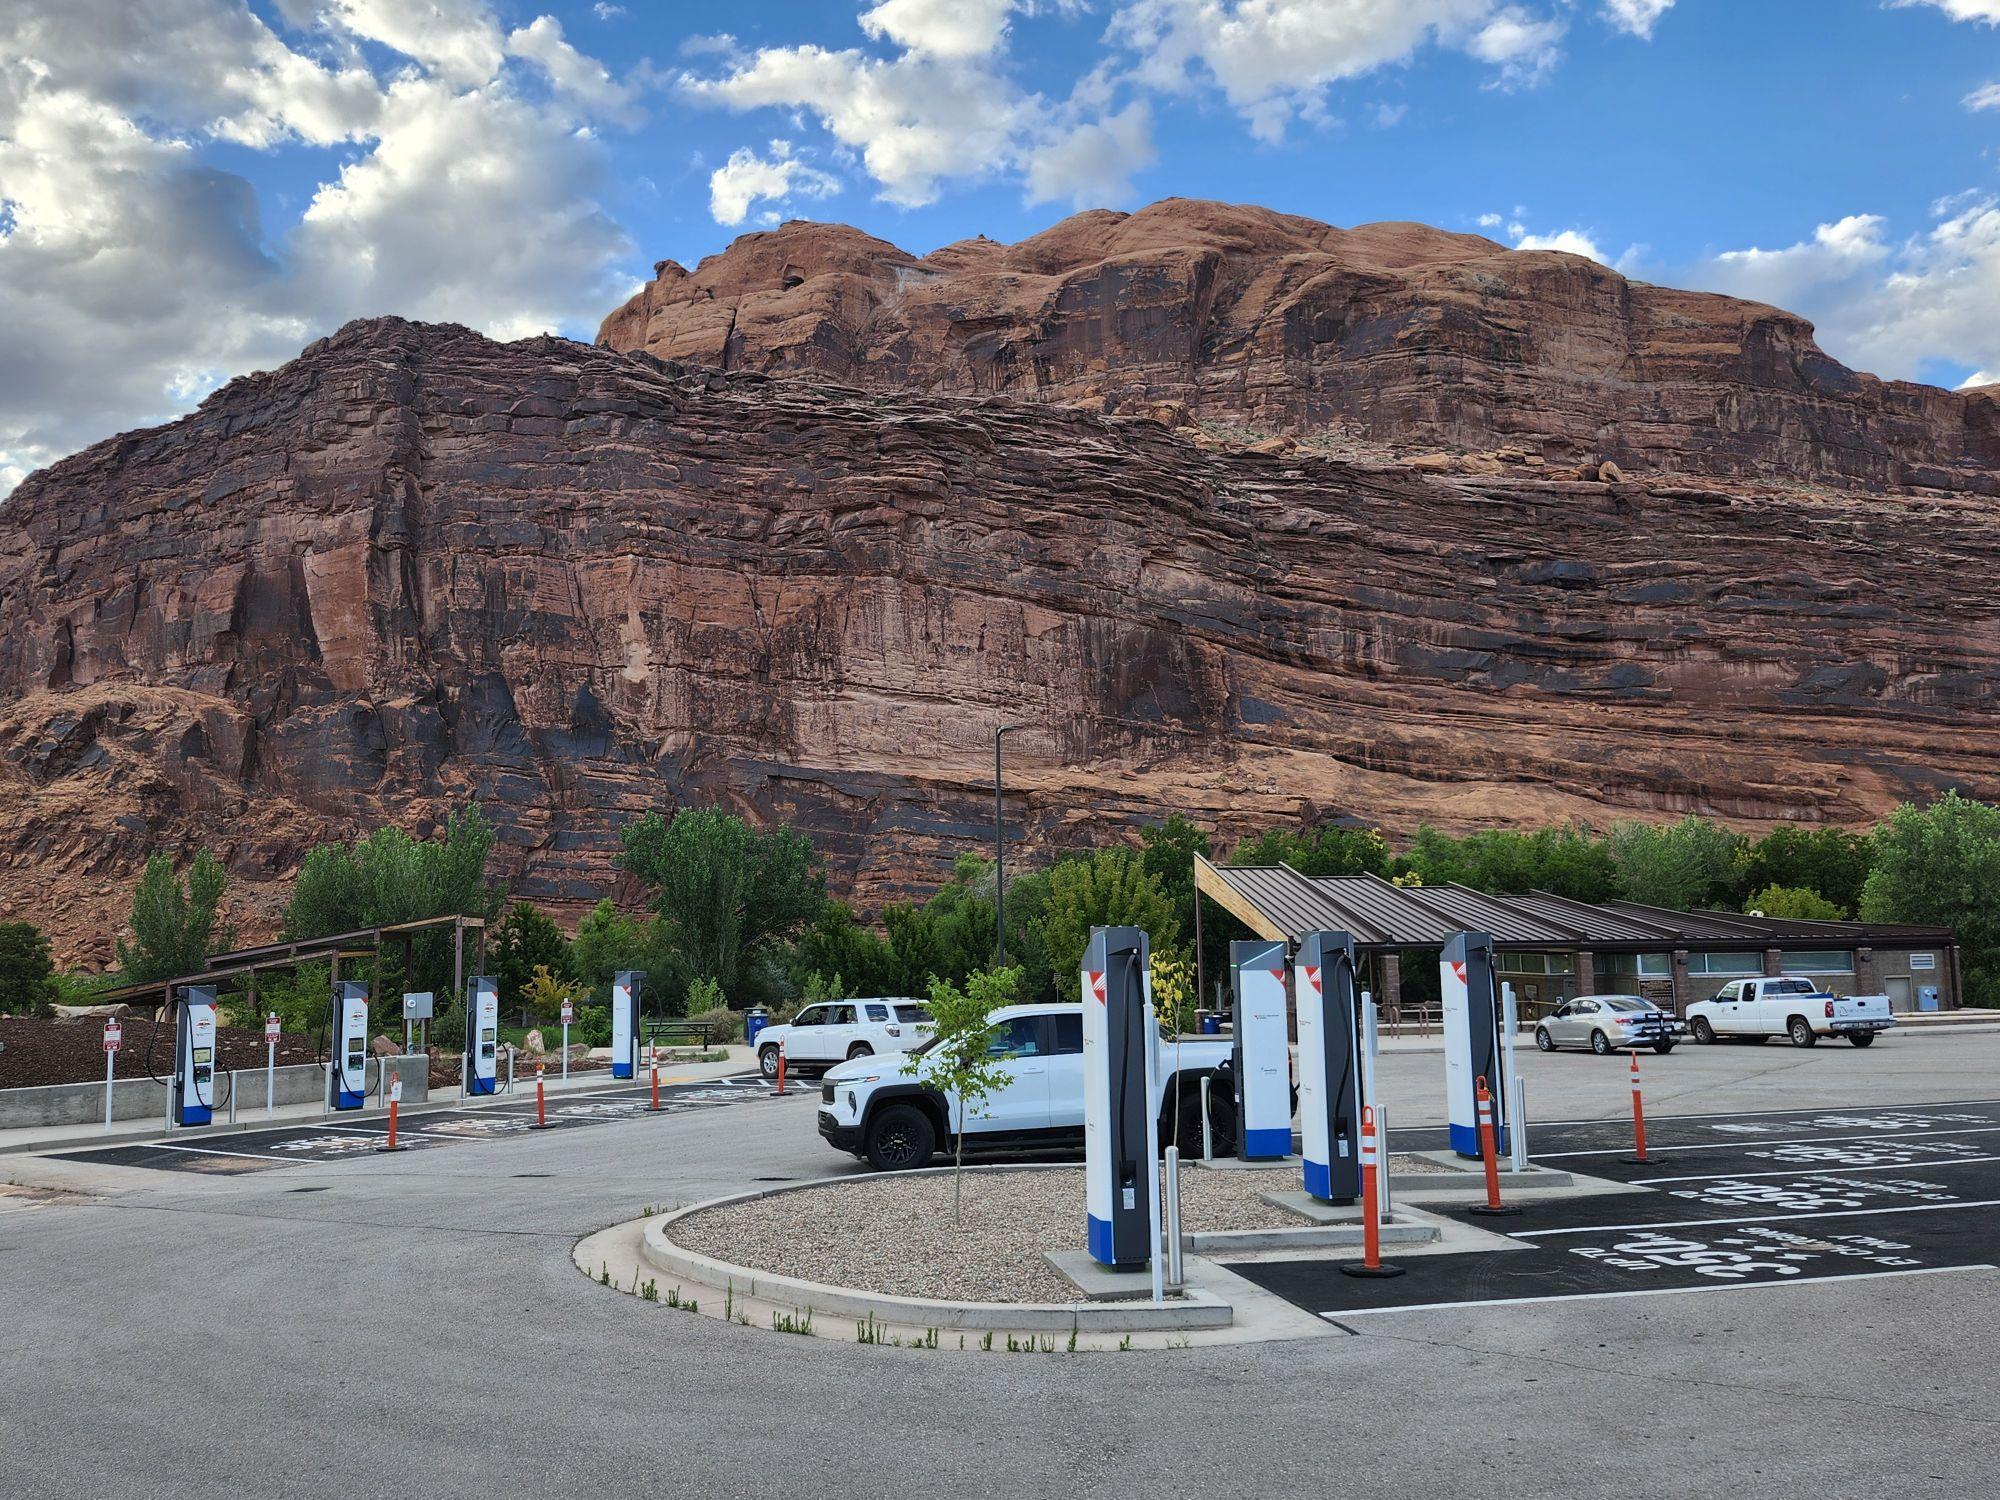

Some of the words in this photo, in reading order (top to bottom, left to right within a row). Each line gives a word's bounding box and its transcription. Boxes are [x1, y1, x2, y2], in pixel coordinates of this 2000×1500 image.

[1773, 1147, 1911, 1164] 350
[1703, 1185, 1863, 1210] 350
[1826, 1234, 1912, 1250] ONLY
[1567, 1247, 1620, 1259] TO
[1612, 1240, 1801, 1278] 350
[1861, 1255, 1923, 1266] EV
[1603, 1258, 1661, 1270] UP
